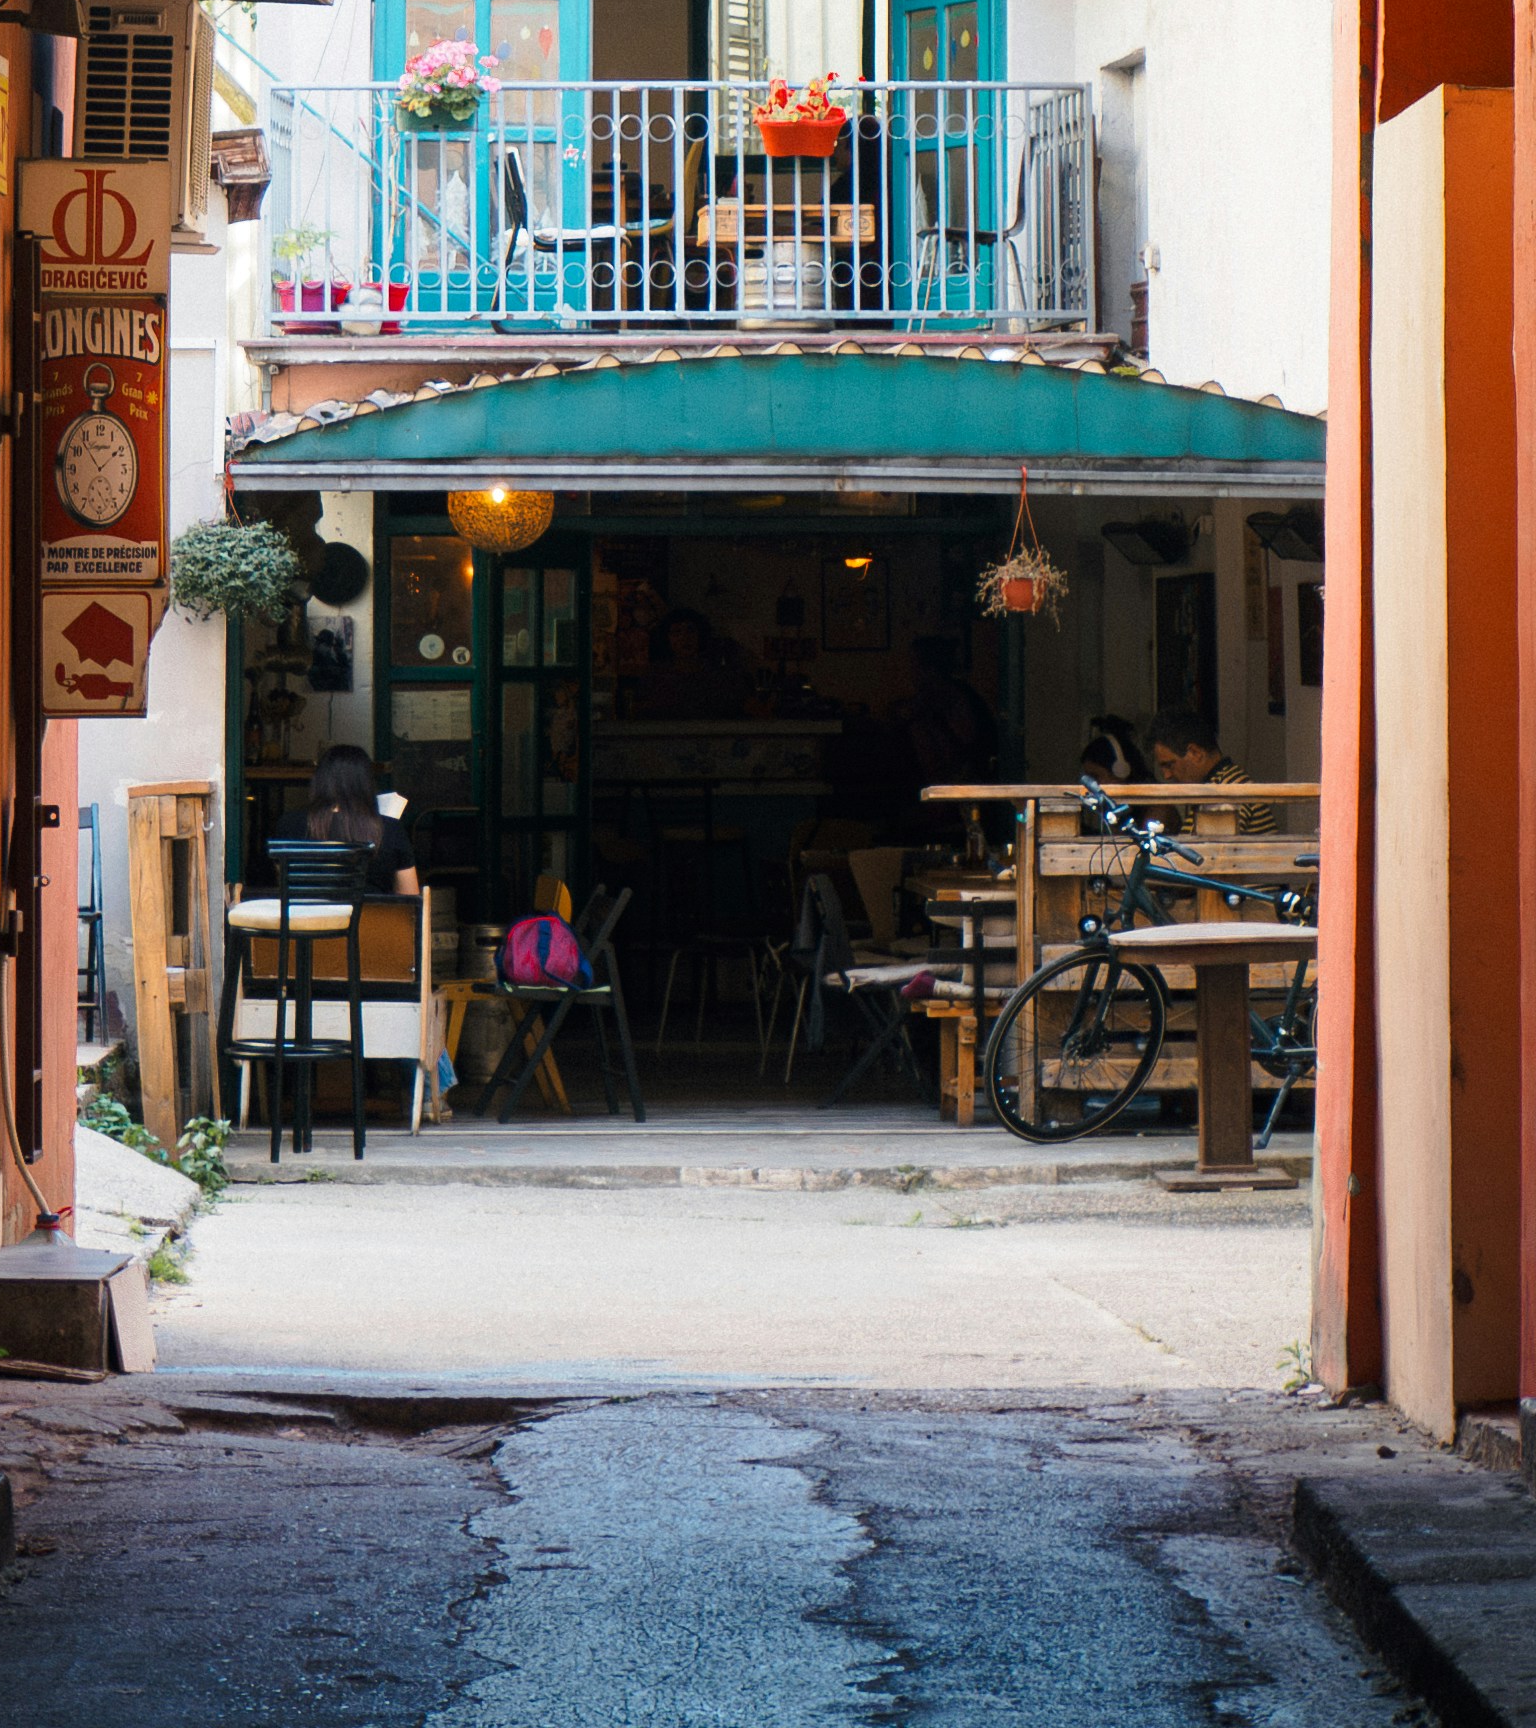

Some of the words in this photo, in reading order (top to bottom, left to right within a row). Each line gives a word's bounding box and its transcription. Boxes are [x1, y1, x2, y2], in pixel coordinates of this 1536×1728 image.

[41, 267, 148, 290] DRAGIĆEVIĆ
[41, 307, 161, 365] ONGINES
[136, 372, 143, 382] 7
[121, 382, 143, 400] Gran
[129, 403, 148, 421] Prix
[47, 547, 90, 559] MONTRE
[91, 547, 104, 559] DE
[47, 561, 69, 573] PAR
[74, 561, 143, 573] EXCELLENCE
